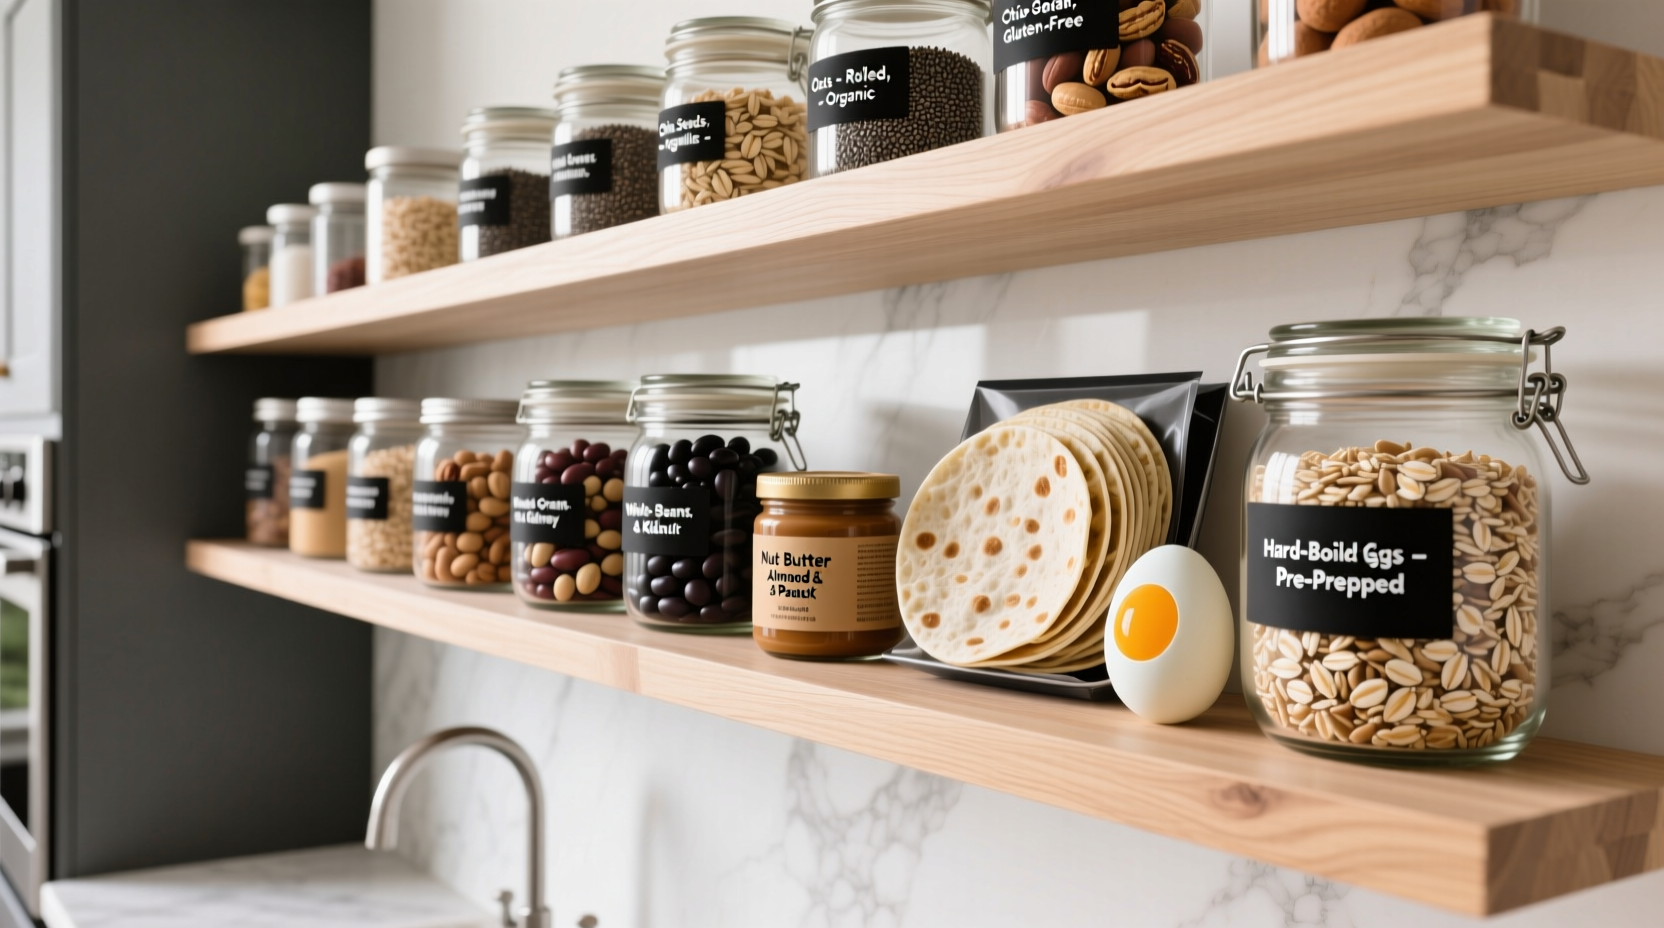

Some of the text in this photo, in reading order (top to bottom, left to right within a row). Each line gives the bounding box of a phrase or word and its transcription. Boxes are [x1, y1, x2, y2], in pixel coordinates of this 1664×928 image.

[1003, 15, 1084, 44] Gluten-Free
[825, 84, 876, 108] Organic
[761, 550, 832, 569] Nut Butter
[1275, 566, 1406, 599] Pre-Prepped
